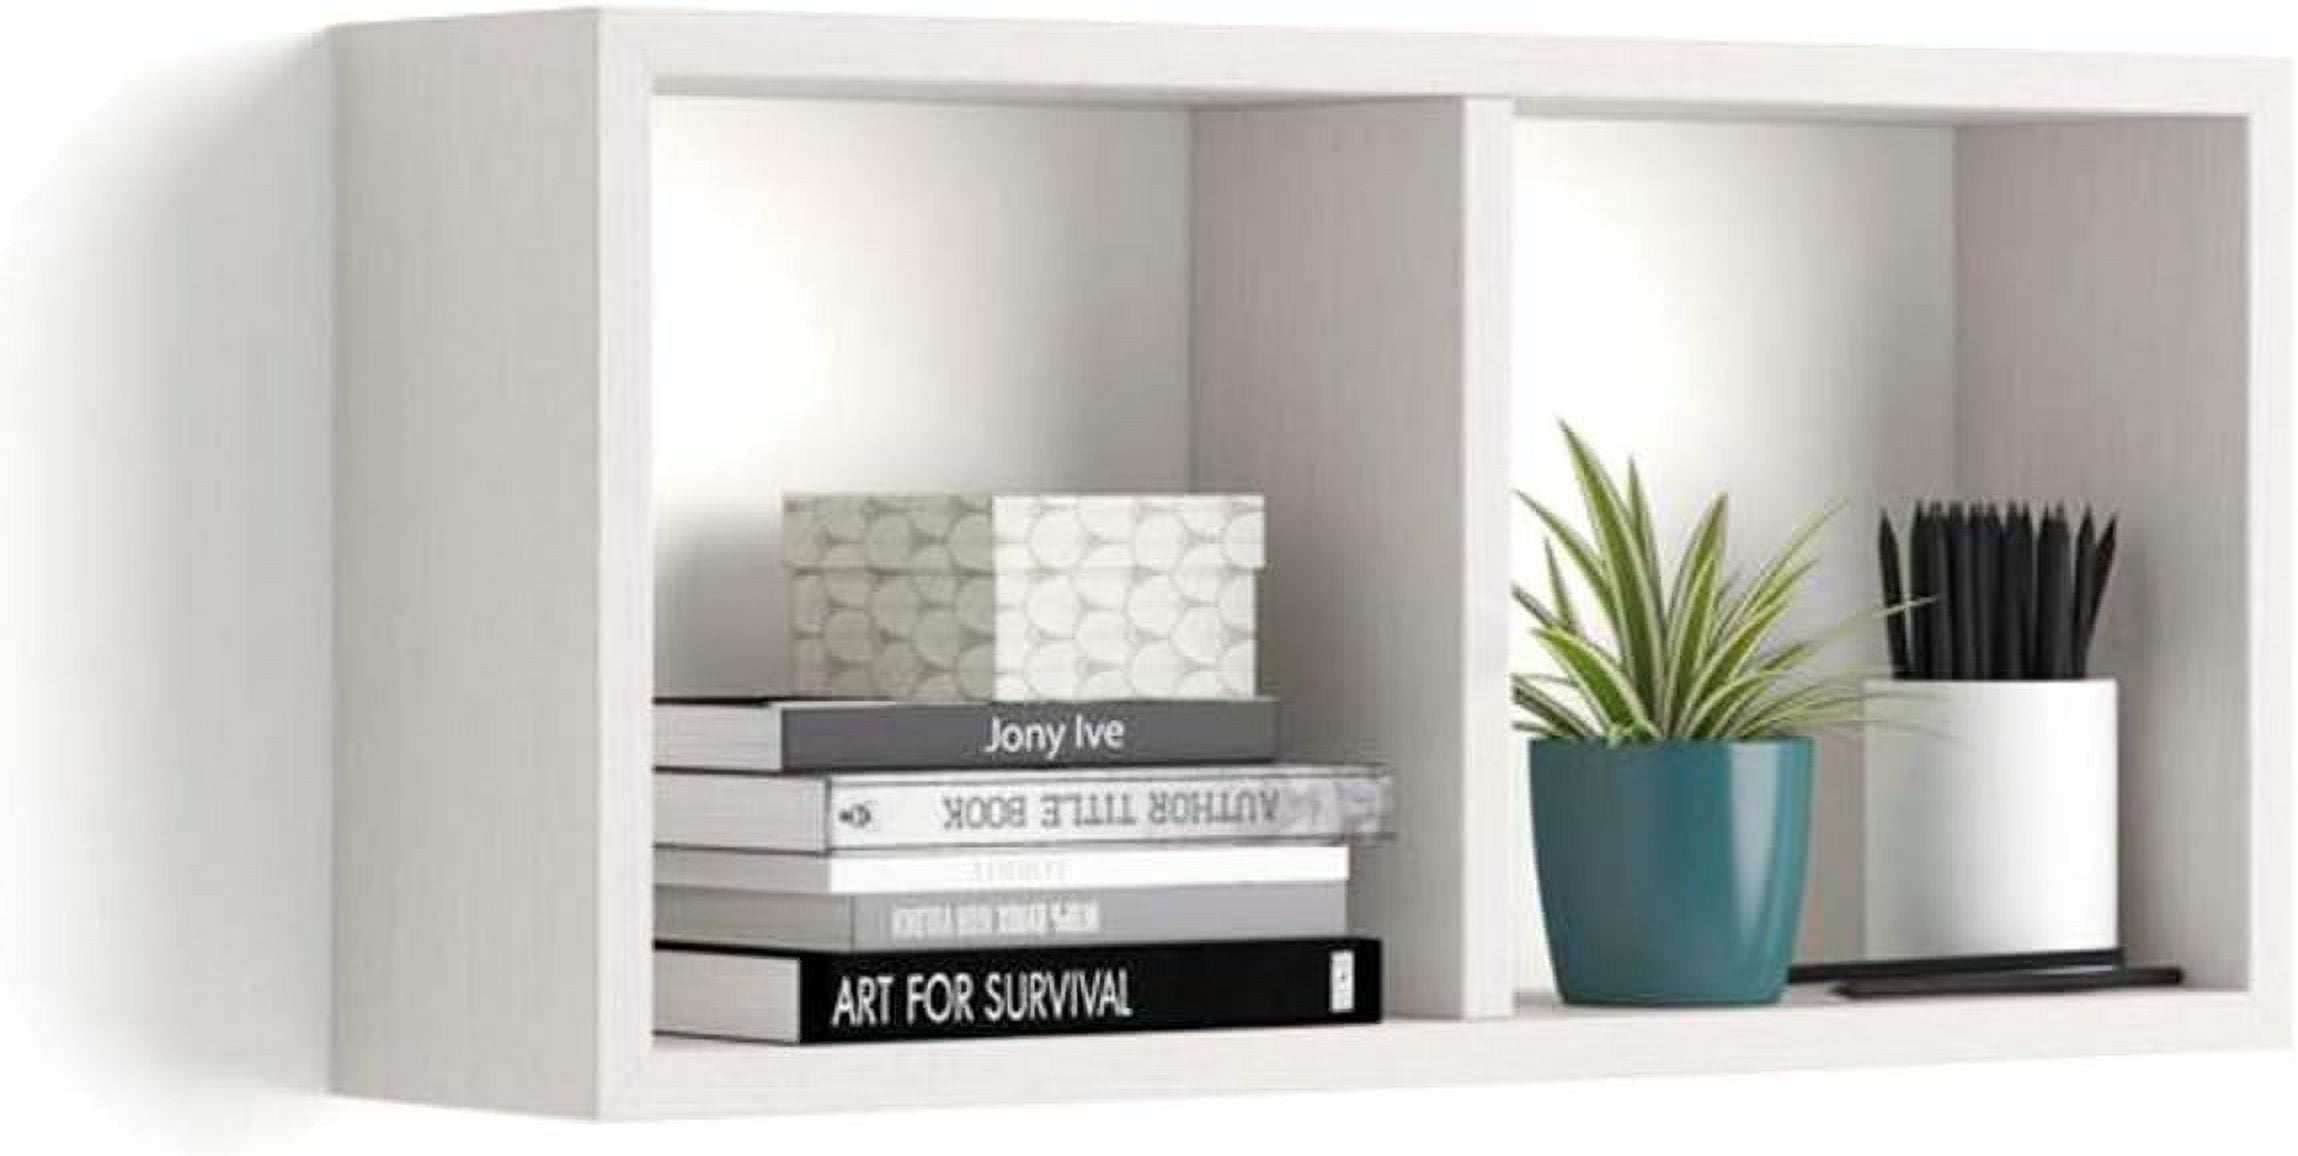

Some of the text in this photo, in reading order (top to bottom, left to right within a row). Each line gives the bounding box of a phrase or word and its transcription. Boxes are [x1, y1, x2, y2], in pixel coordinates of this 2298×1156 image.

[984, 714, 1126, 759] Jony Ive
[943, 789, 1280, 830] AUTHOR TITLE BOOK
[831, 967, 1133, 1027] ART FOR SURVIVAL
